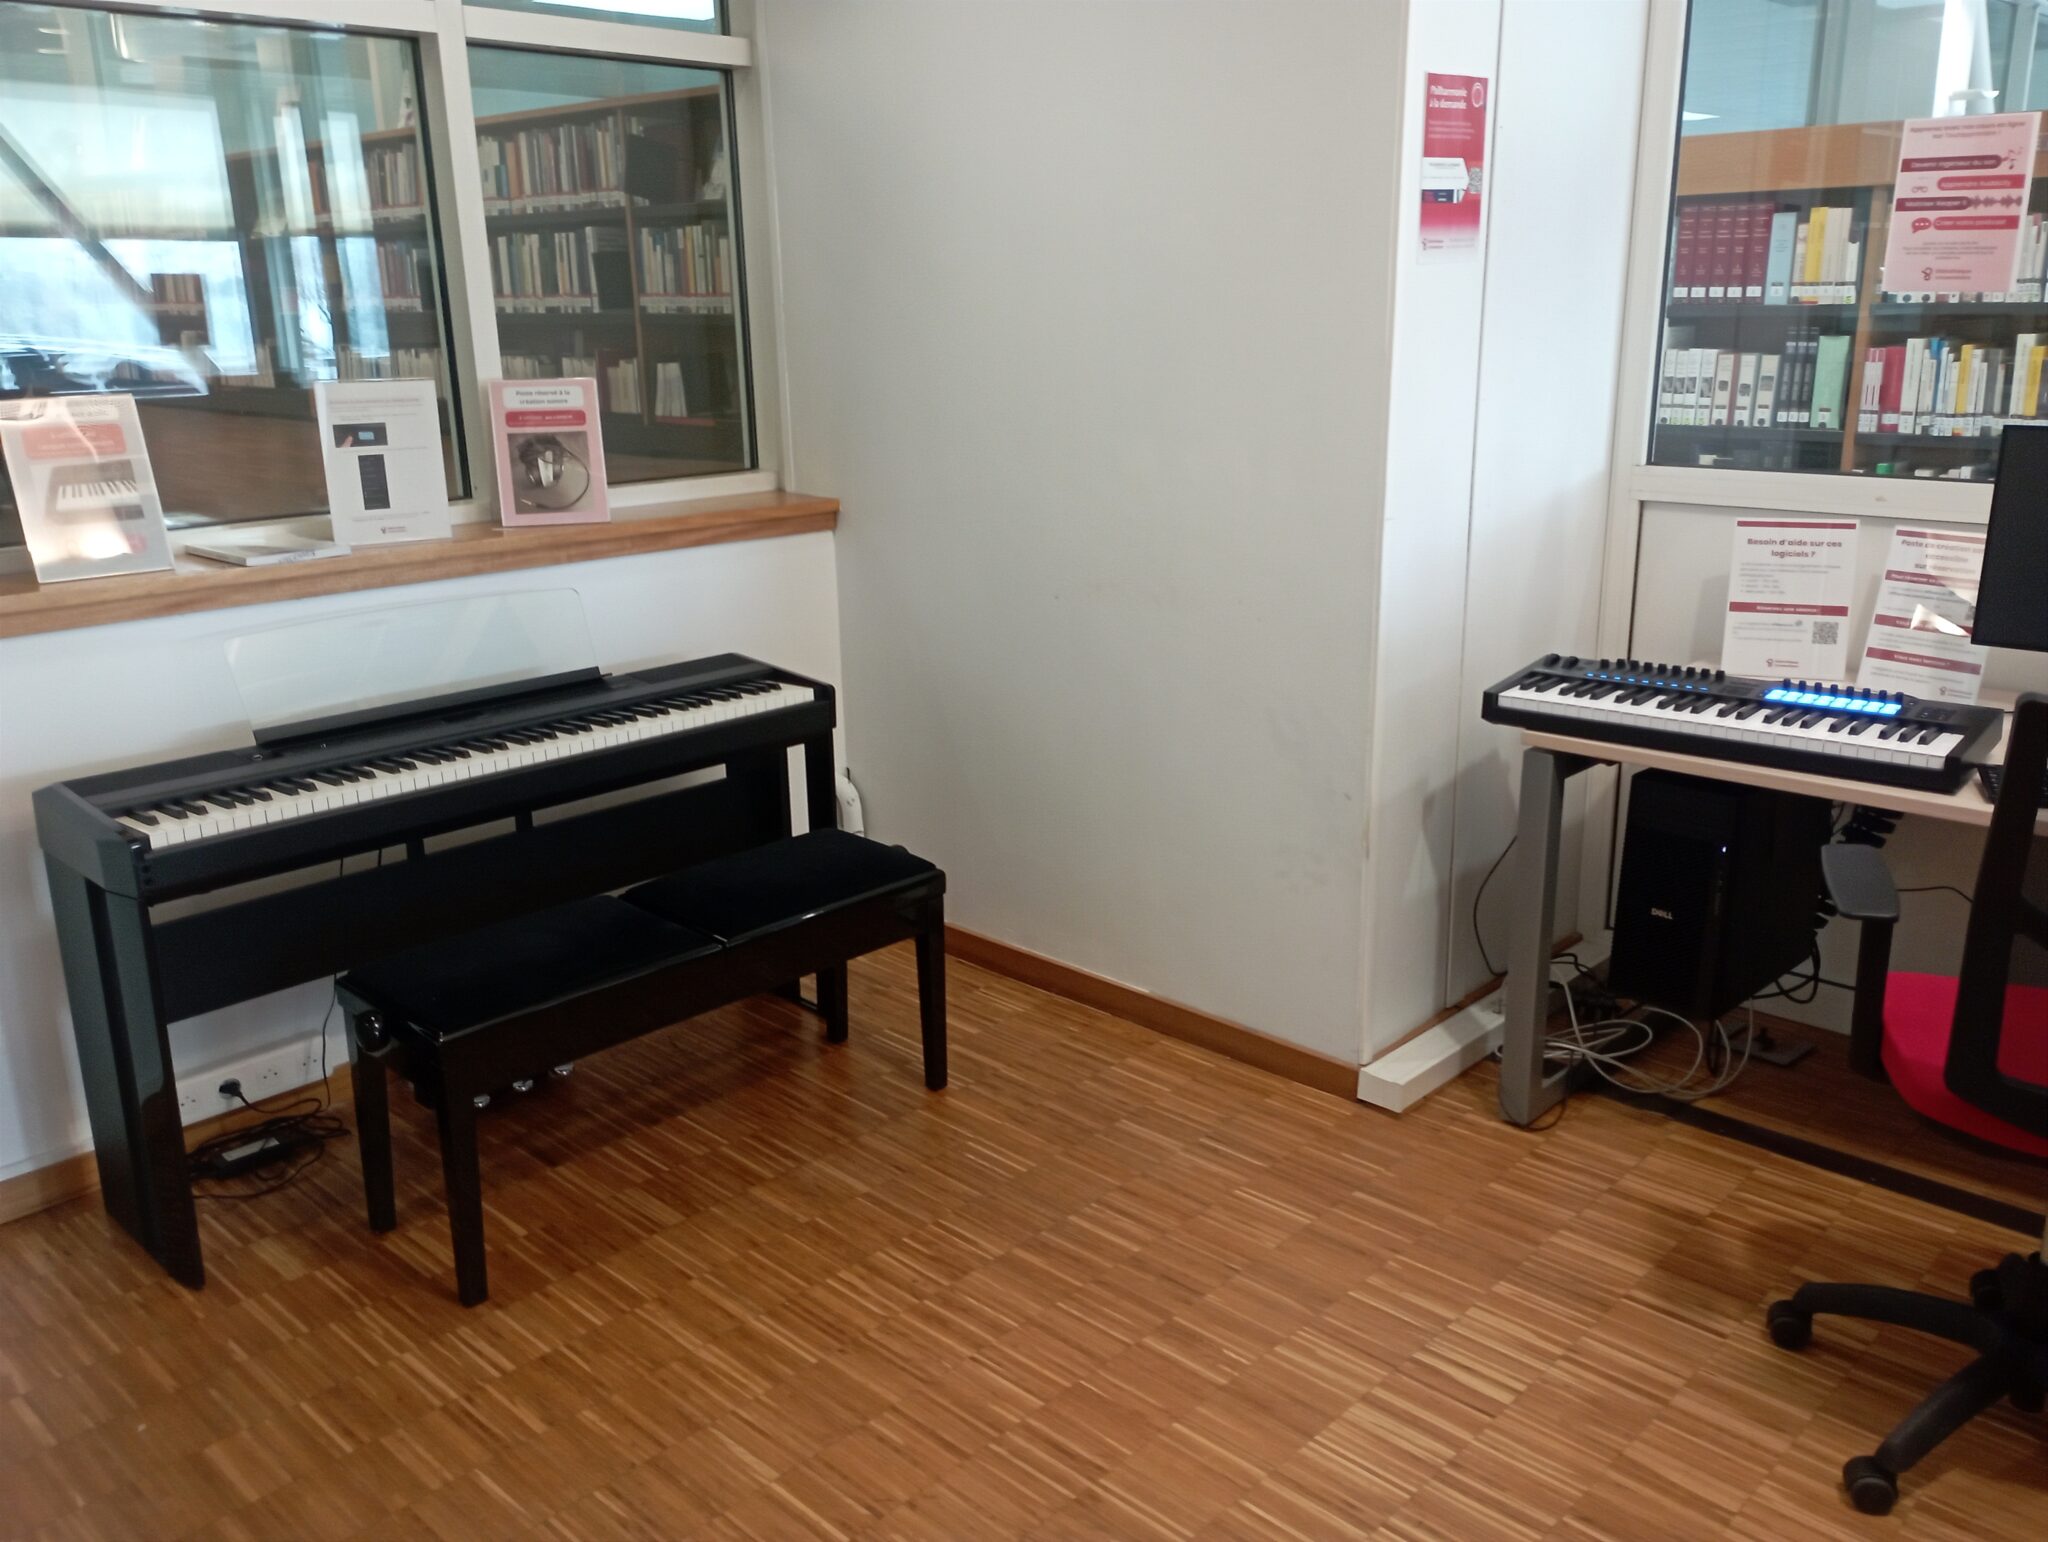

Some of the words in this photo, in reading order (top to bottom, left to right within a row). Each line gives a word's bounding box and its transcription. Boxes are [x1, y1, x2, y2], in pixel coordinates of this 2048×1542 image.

[1439, 98, 1467, 110] demande
[1746, 537, 1778, 546] Besoin
[1778, 538, 1808, 547] d'aide
[1809, 540, 1825, 548] sur
[1825, 540, 1843, 548] ces
[1770, 549, 1809, 559] logiciels
[1650, 907, 1673, 920] DELL
